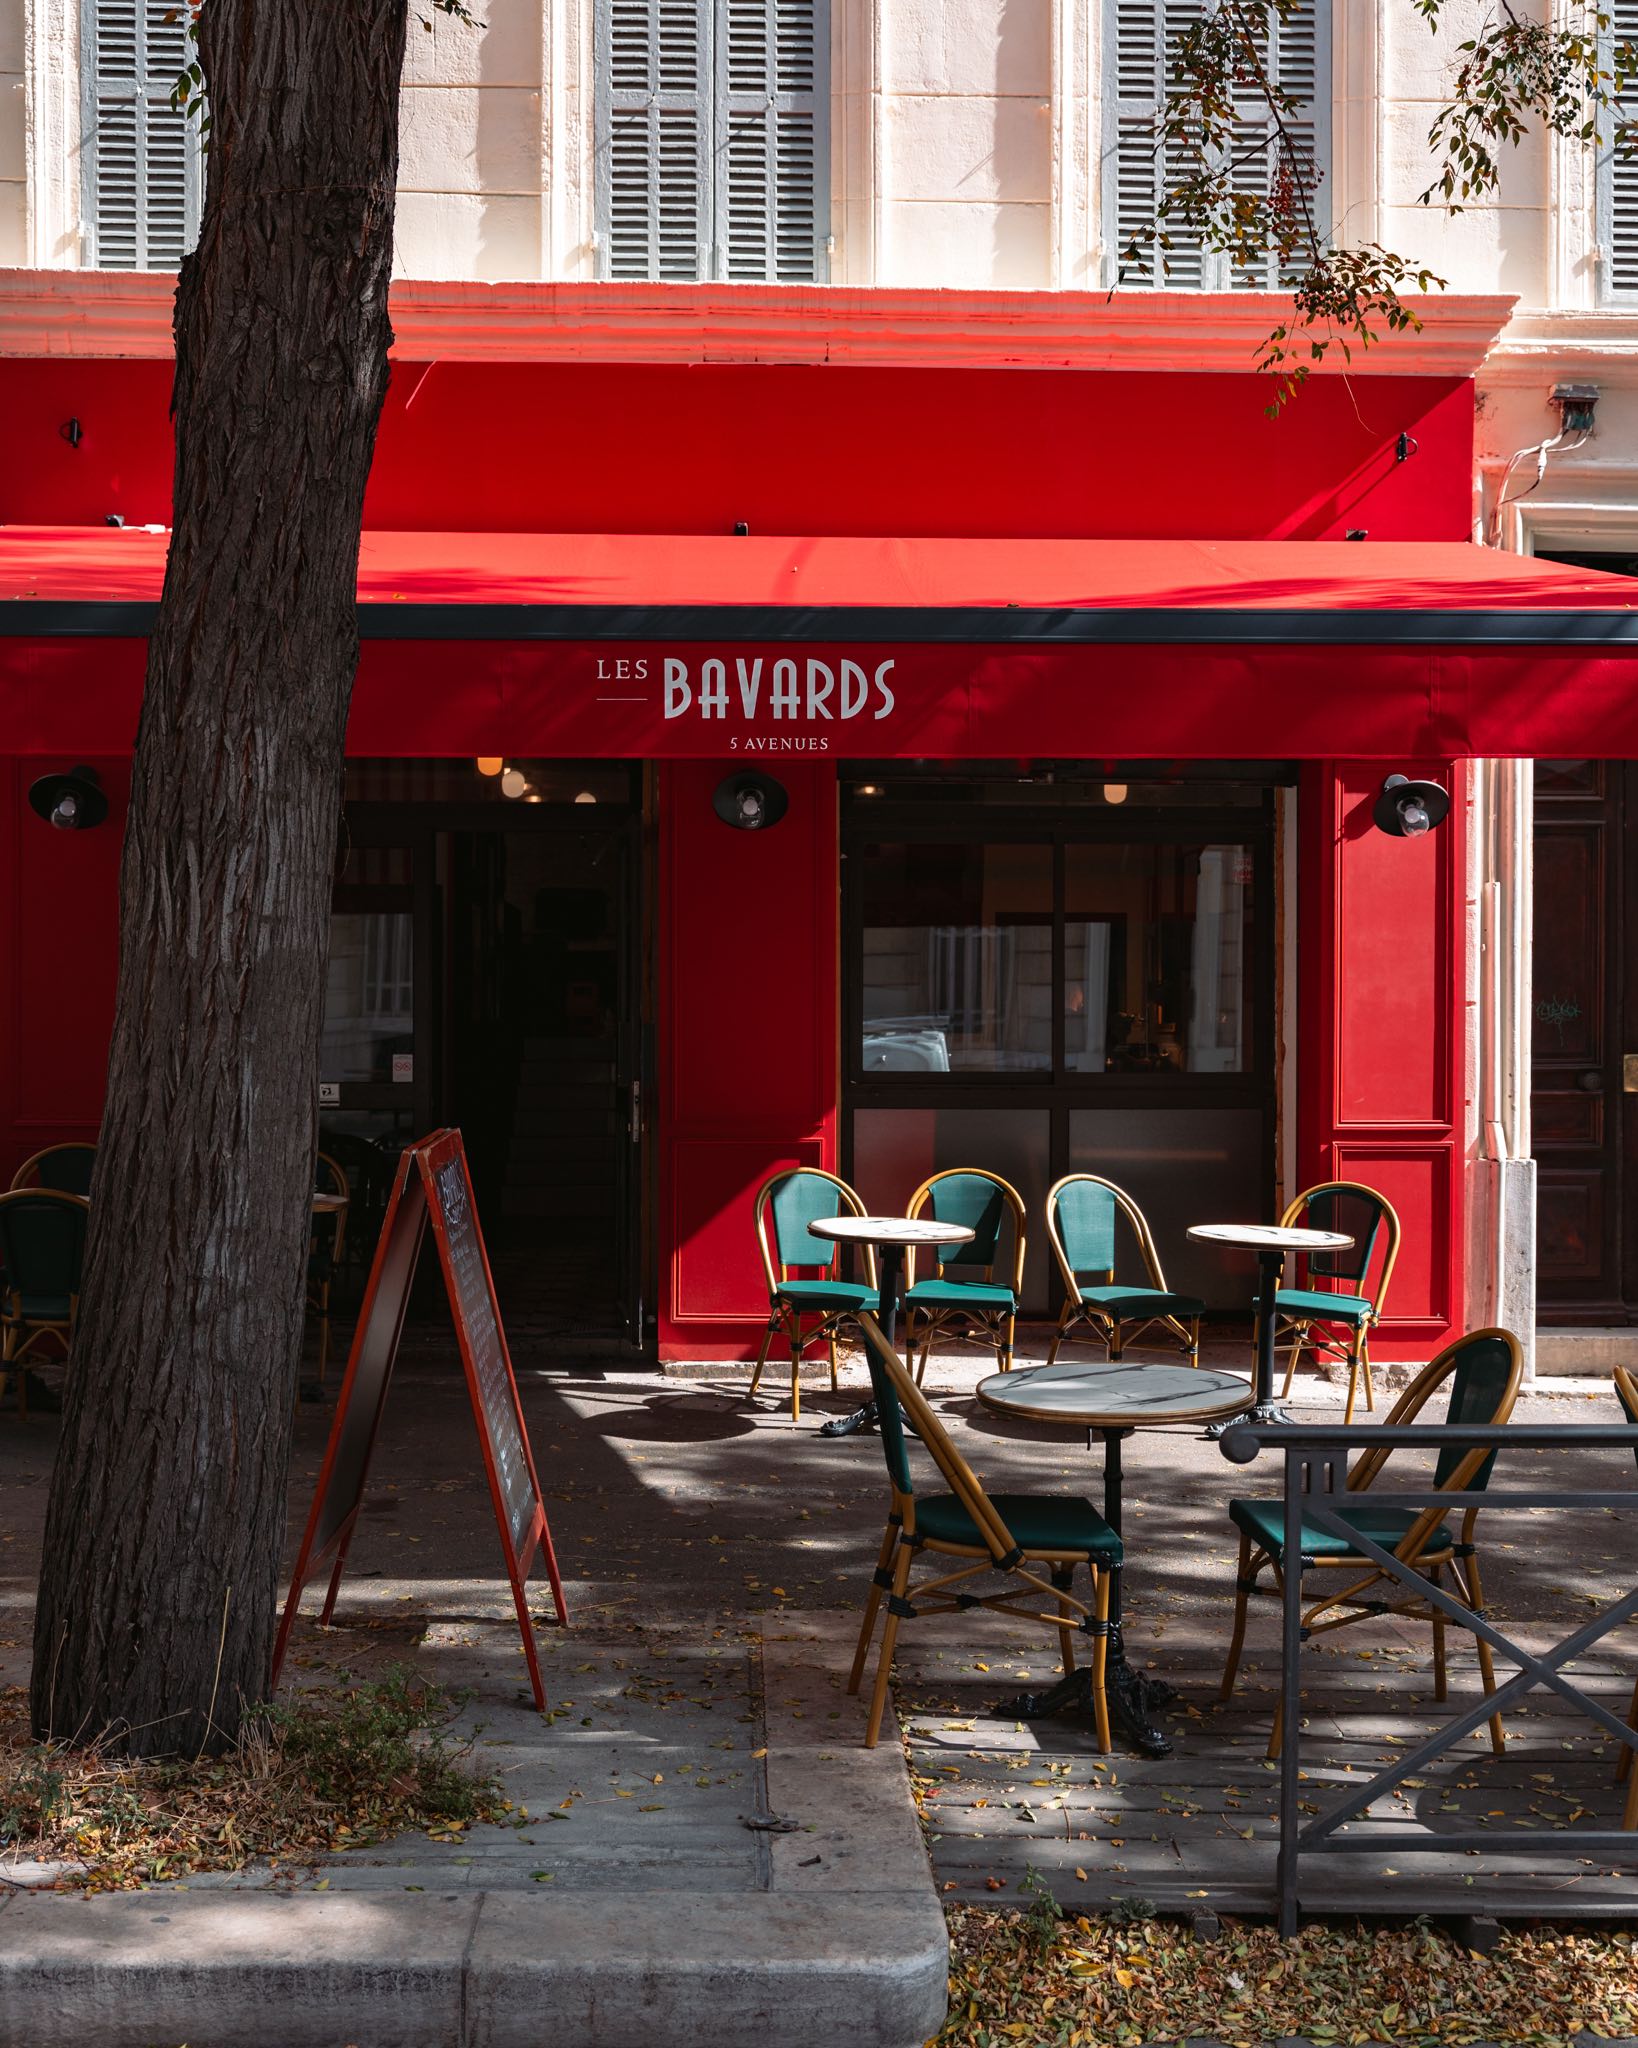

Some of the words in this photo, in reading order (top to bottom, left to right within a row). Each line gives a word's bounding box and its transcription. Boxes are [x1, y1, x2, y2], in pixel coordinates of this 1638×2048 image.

[597, 659, 648, 680] LES
[664, 658, 895, 720] BAVARDS
[729, 737, 738, 751] 5
[744, 737, 829, 751] AVENUES
